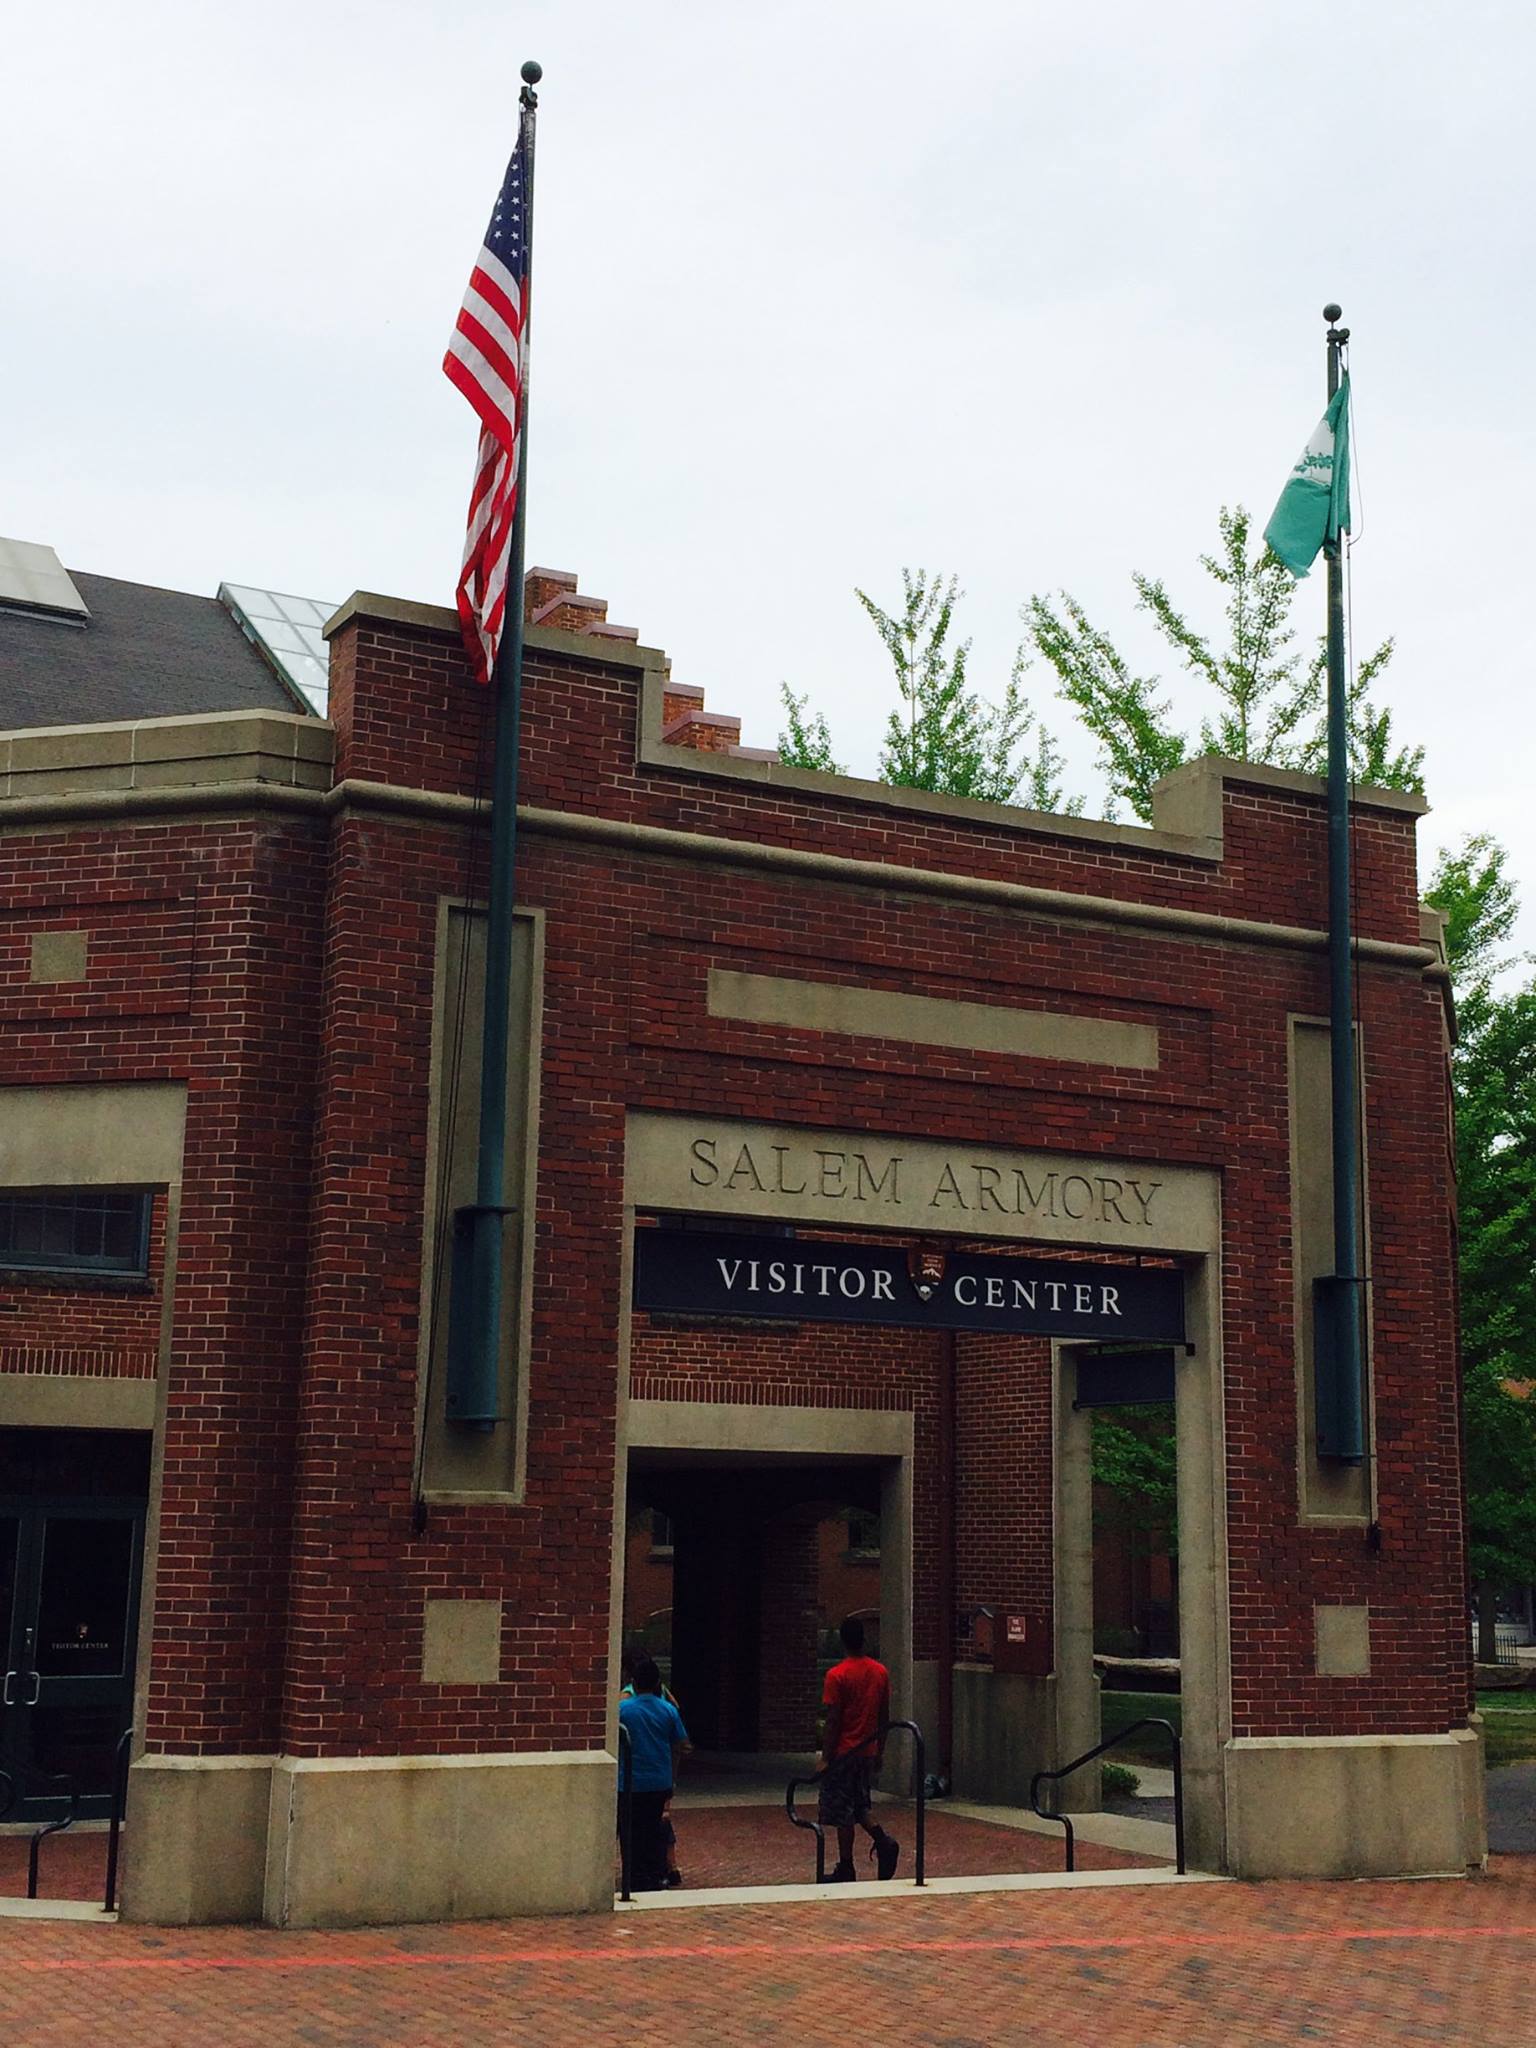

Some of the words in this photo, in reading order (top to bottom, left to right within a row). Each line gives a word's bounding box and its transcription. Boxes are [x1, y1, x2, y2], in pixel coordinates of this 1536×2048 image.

[690, 1139, 903, 1204] SALEM
[928, 1163, 1163, 1226] ARMORY
[716, 1258, 896, 1300] VISITOR
[954, 1275, 1123, 1316] CENTER
